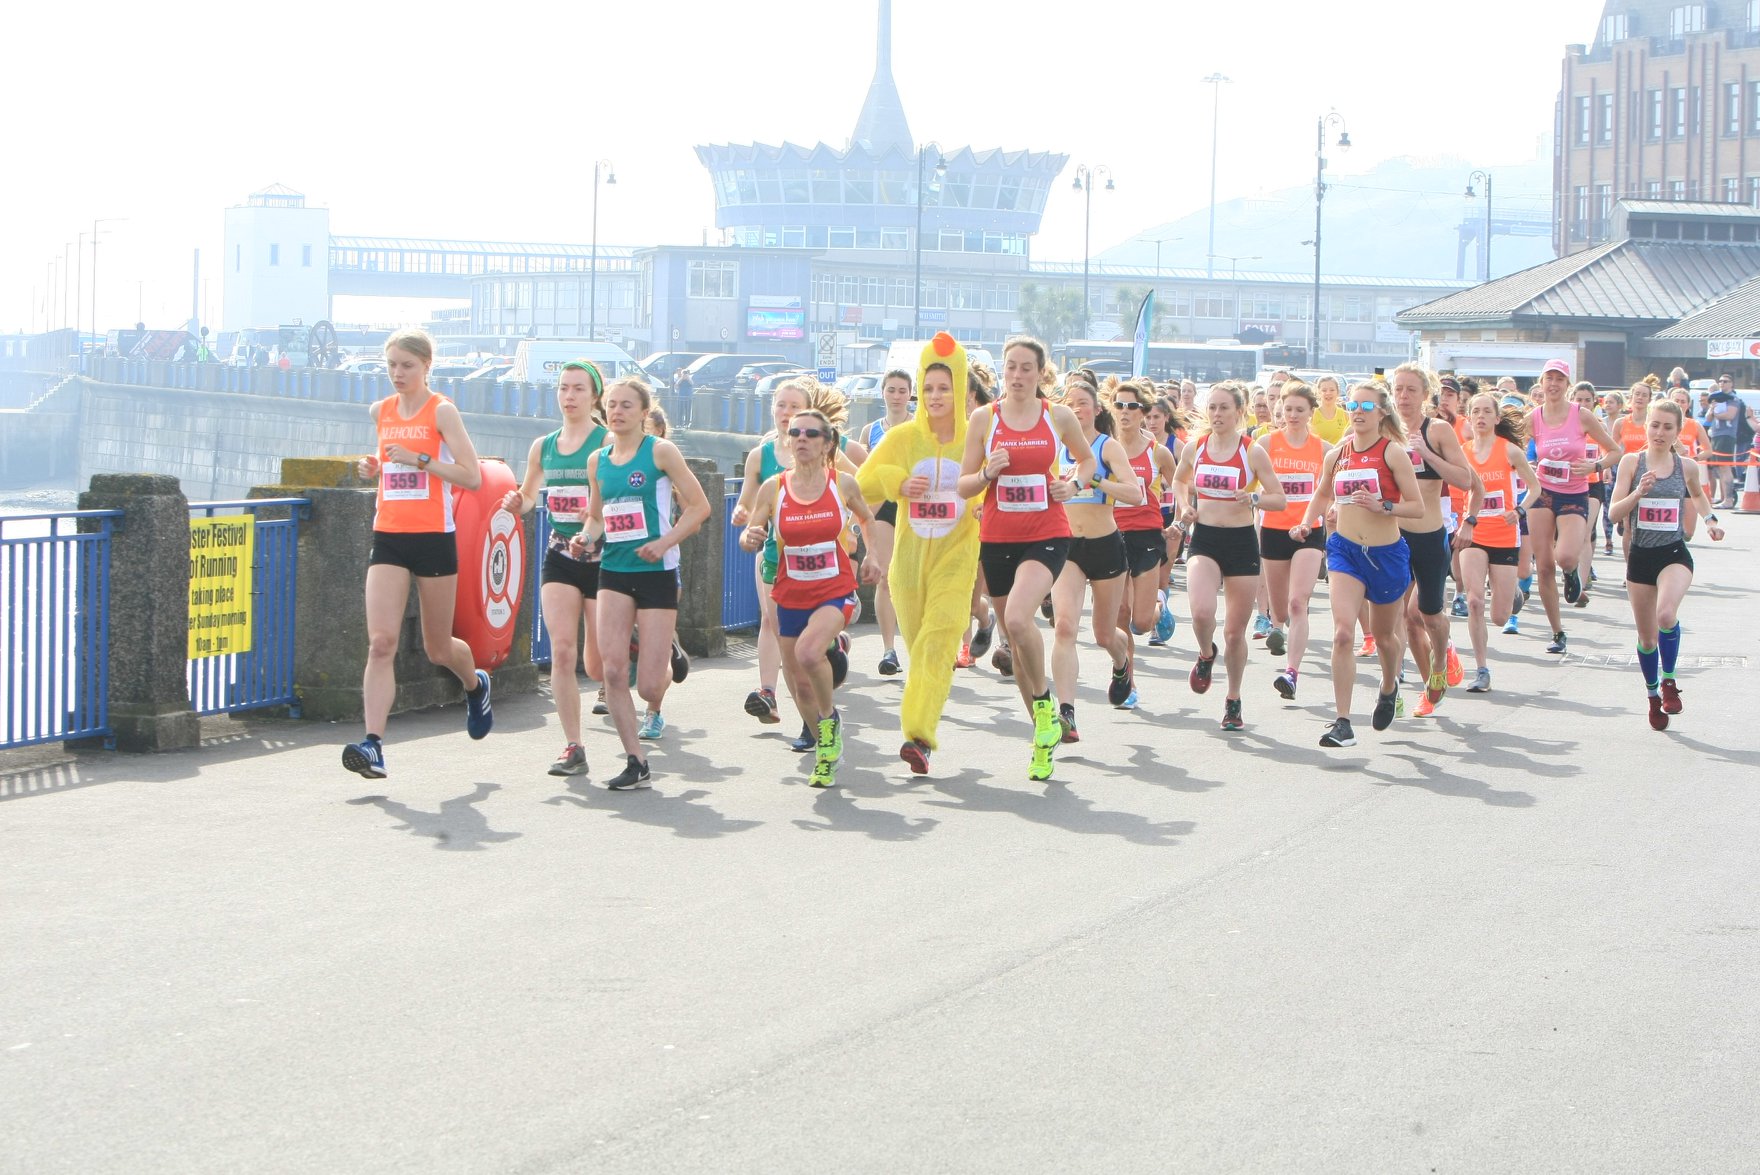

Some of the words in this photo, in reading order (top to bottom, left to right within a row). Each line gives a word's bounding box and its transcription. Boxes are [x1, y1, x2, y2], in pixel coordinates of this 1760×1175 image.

[819, 371, 835, 380] OUT
[389, 473, 418, 489] 559
[1203, 474, 1230, 489] 584
[1282, 481, 1305, 495] 561
[1005, 486, 1035, 503] 581
[553, 497, 579, 512] 528
[918, 502, 948, 518] 549
[1483, 497, 1498, 510] 70
[804, 511, 834, 520] HARRIERS
[1646, 508, 1672, 523] 612
[190, 527, 210, 549] ster
[212, 522, 247, 548] Festival
[190, 555, 199, 579] of
[200, 553, 238, 578] Running
[796, 554, 827, 571] 583
[191, 587, 213, 606] taking
[215, 585, 234, 605] place
[197, 612, 220, 629] Sunday
[220, 609, 247, 626] morning
[196, 637, 211, 652] 10am
[216, 636, 228, 650] 1pm
